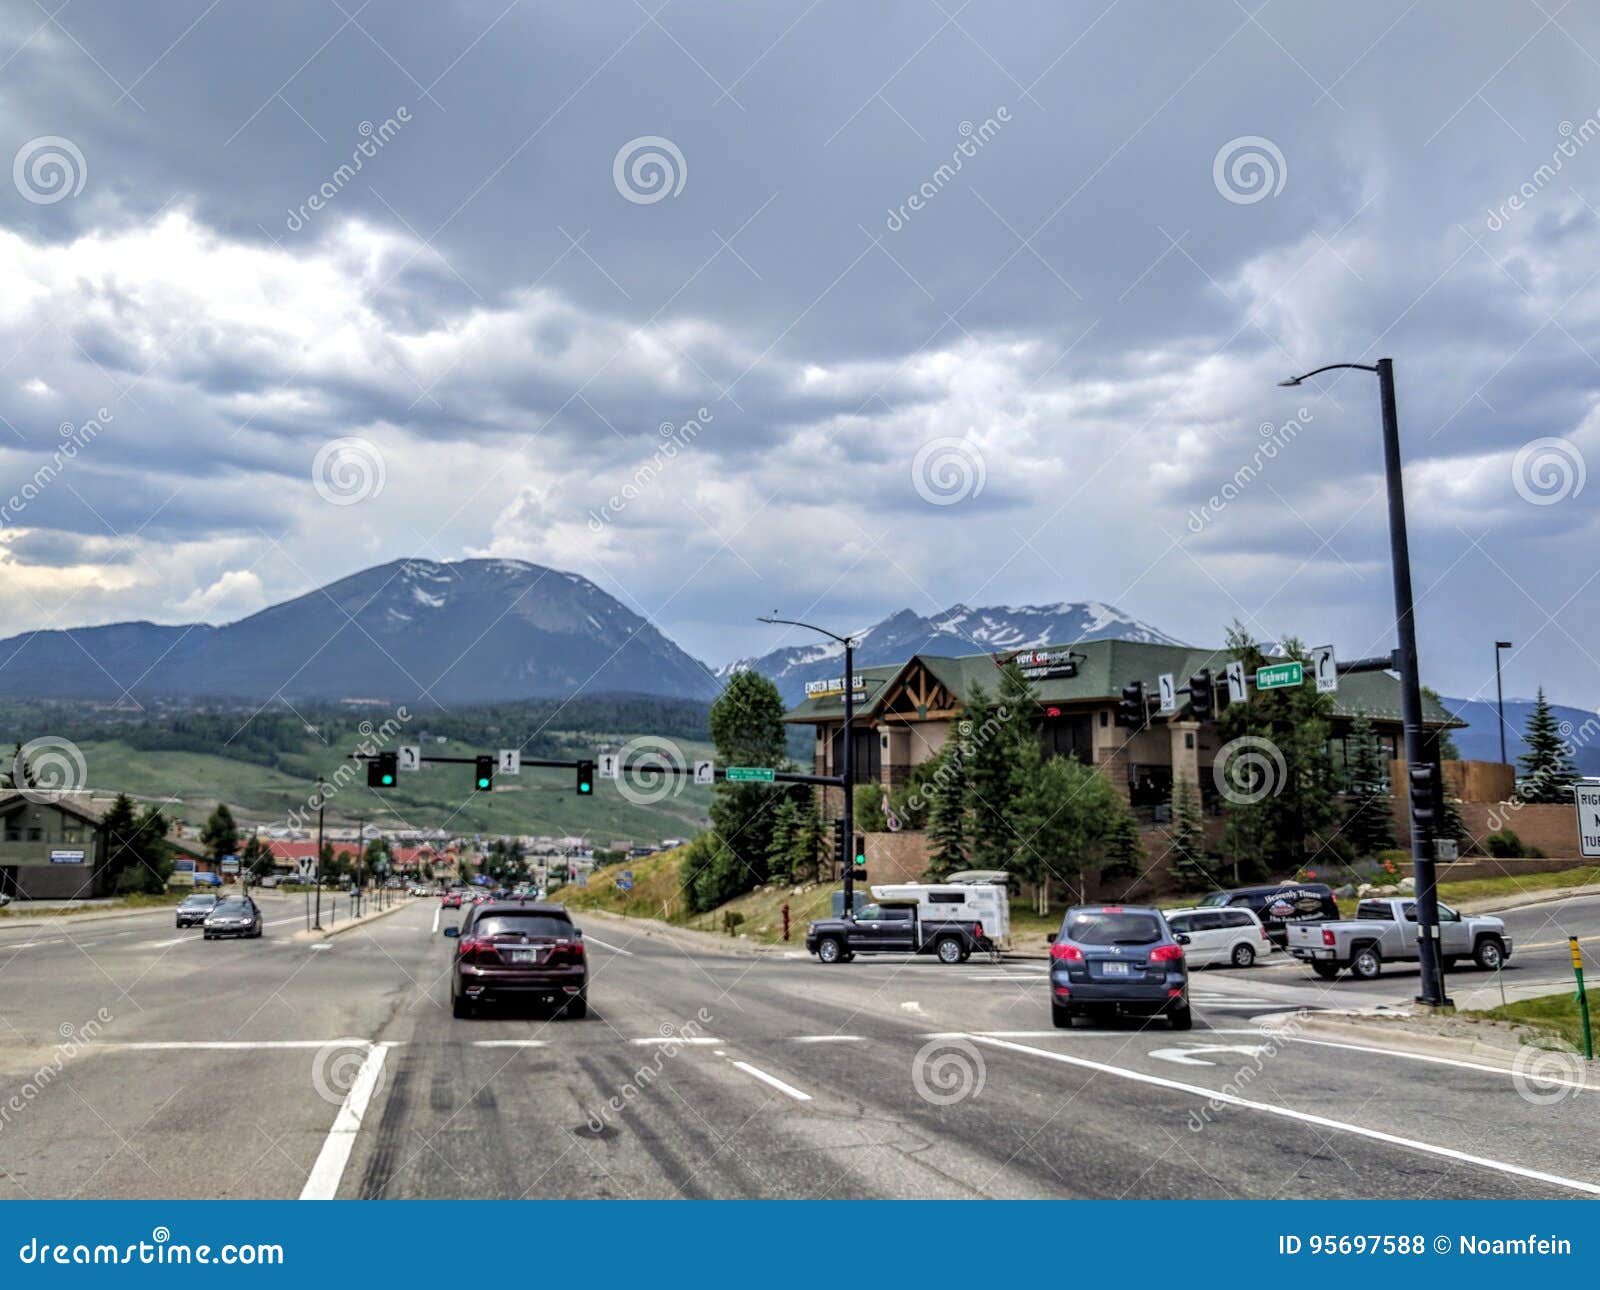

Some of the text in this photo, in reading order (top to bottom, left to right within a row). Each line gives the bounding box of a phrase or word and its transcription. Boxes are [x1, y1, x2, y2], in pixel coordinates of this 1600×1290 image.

[1260, 670, 1288, 685] Highway
[1318, 679, 1335, 689] ONLY
[1580, 794, 1600, 806] RIG
[1298, 890, 1321, 899] Times
